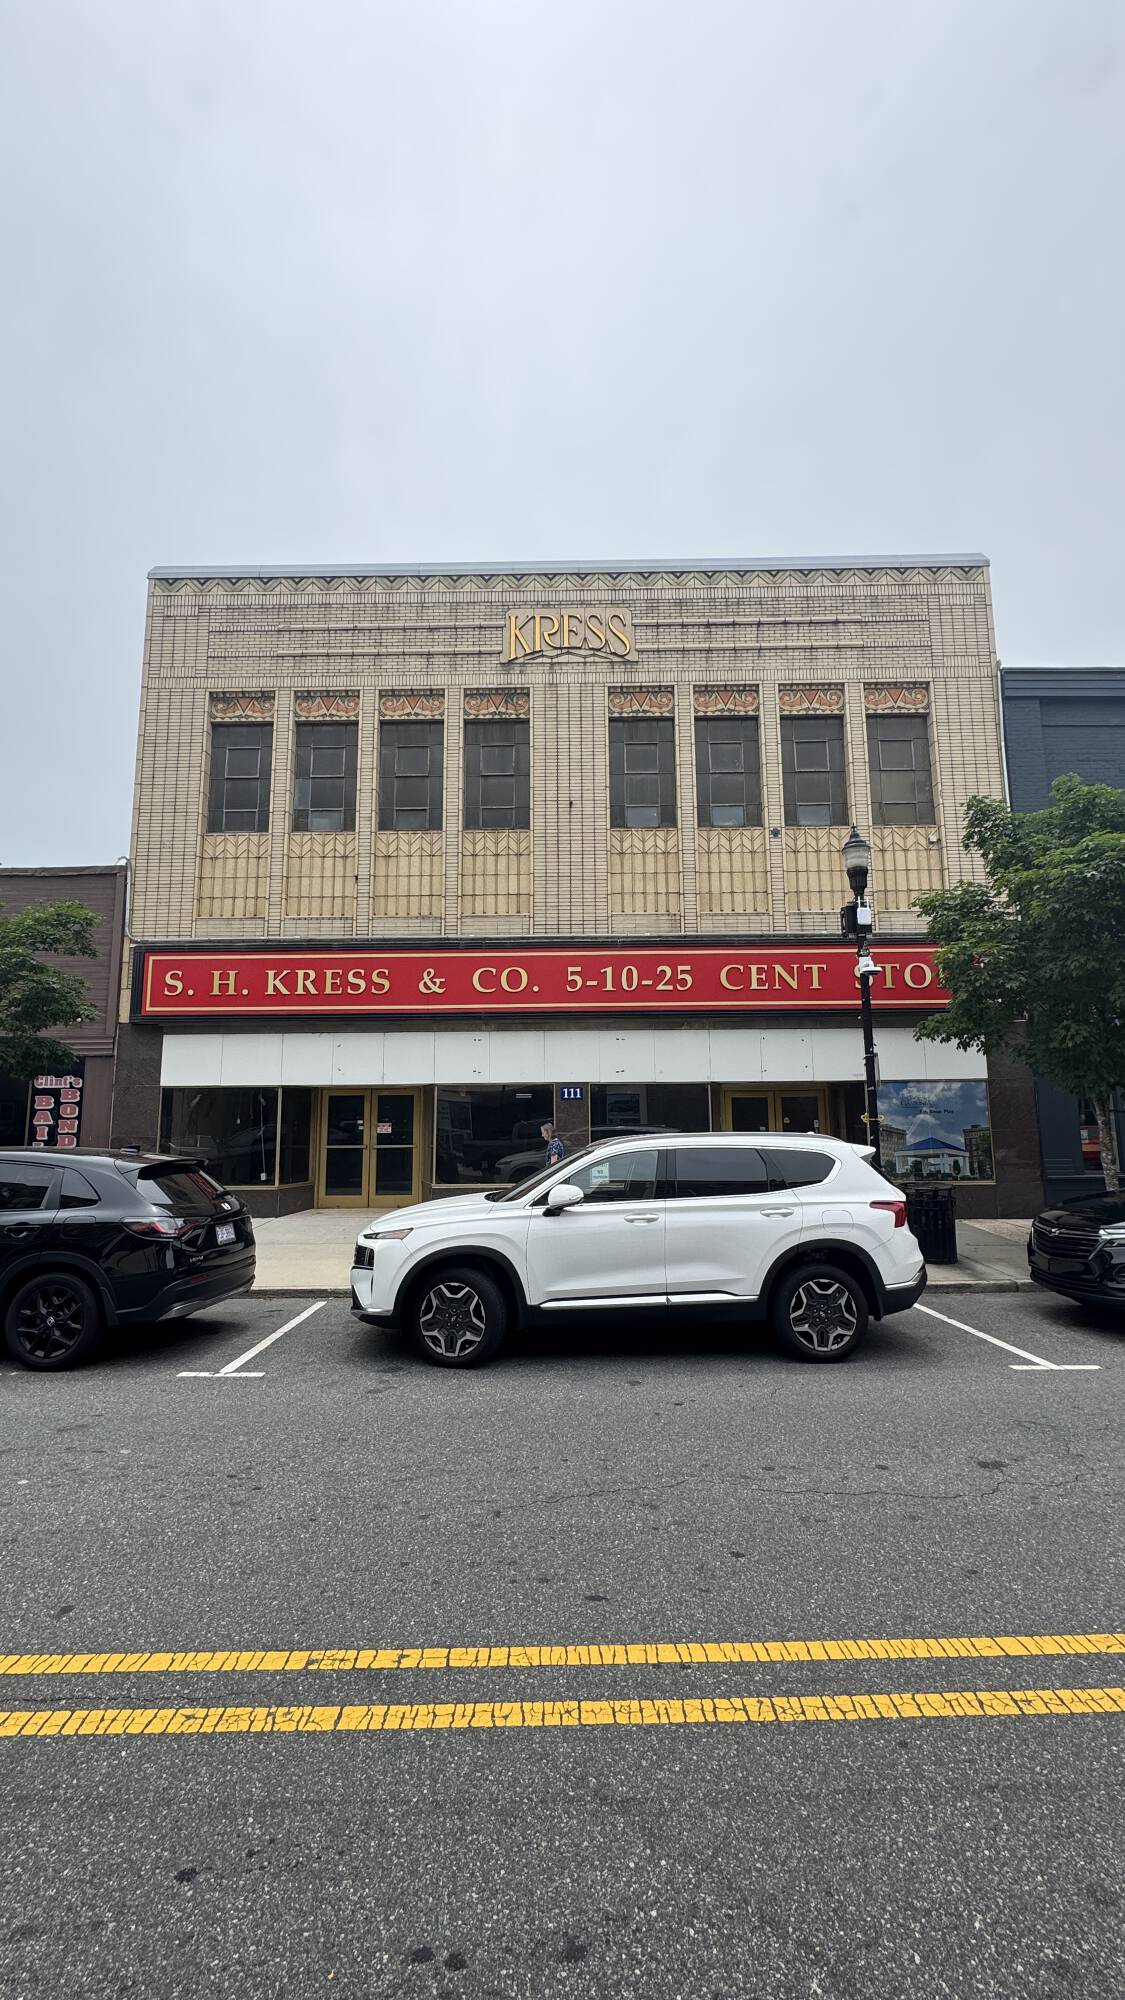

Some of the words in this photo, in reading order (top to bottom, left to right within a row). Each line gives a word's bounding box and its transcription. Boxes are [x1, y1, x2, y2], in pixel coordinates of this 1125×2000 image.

[508, 614, 631, 660] KRESS
[163, 970, 195, 996] S.
[209, 970, 250, 996] H.
[264, 969, 391, 995] KRESS
[418, 968, 447, 994] &
[472, 967, 540, 993] CO.
[566, 965, 694, 992] 5-10-25
[719, 964, 827, 990] CENT
[854, 962, 945, 989] STO
[563, 1088, 581, 1098] 111
[32, 1096, 54, 1147] BAI
